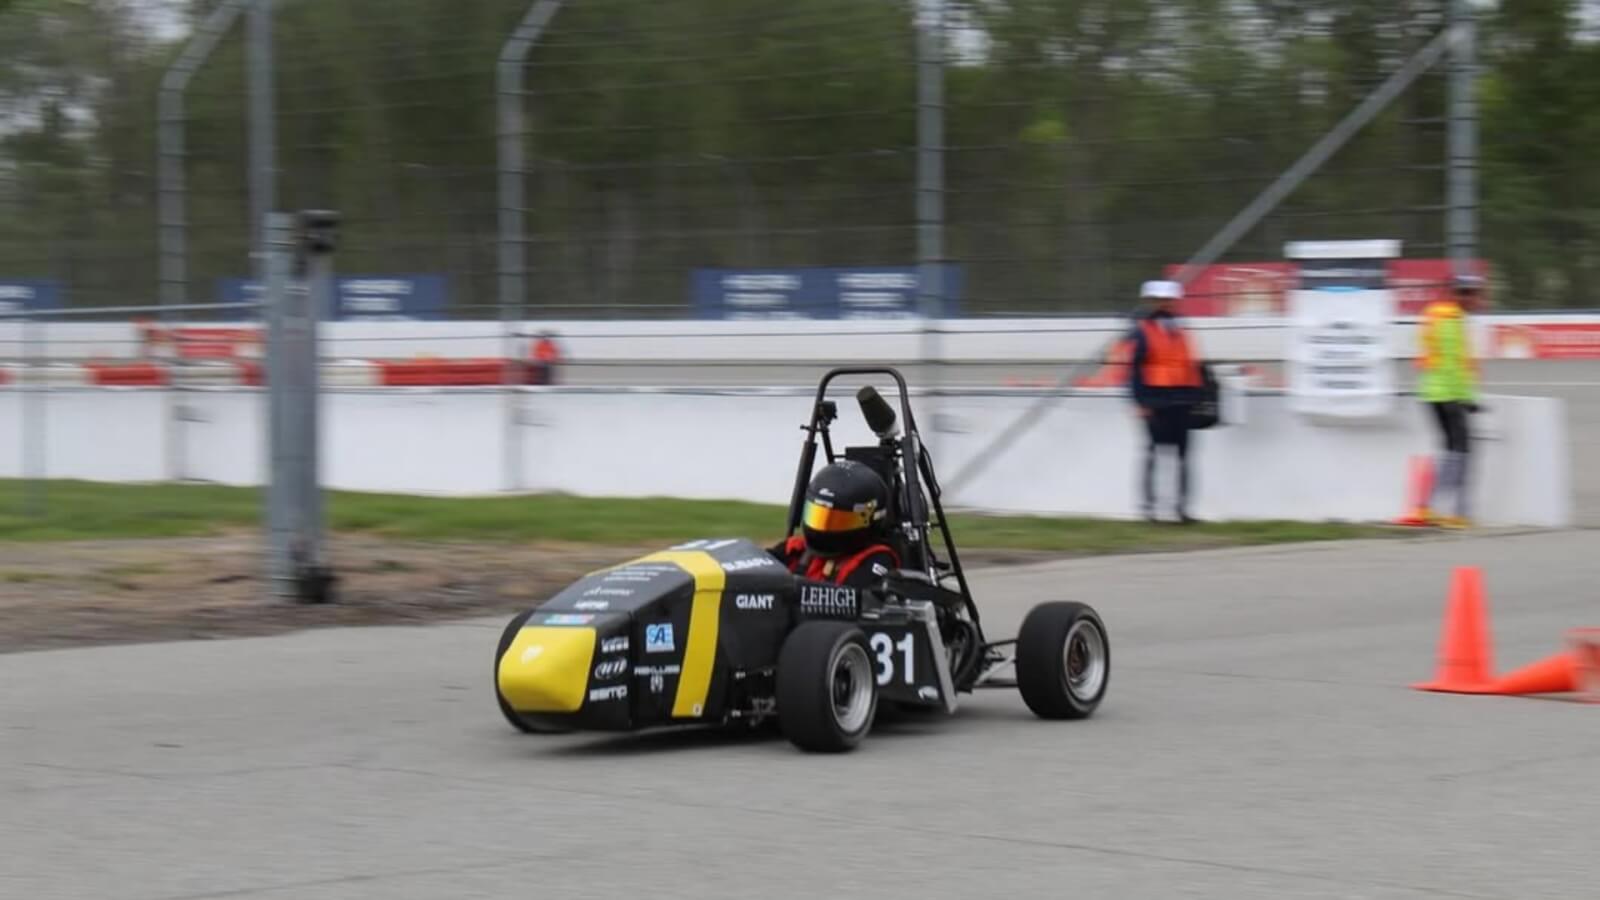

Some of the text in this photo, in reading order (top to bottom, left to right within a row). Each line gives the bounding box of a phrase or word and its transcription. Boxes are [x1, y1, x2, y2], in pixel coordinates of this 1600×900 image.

[735, 594, 774, 609] GIANT
[800, 586, 856, 608] LEHIGH
[869, 632, 914, 686] 31
